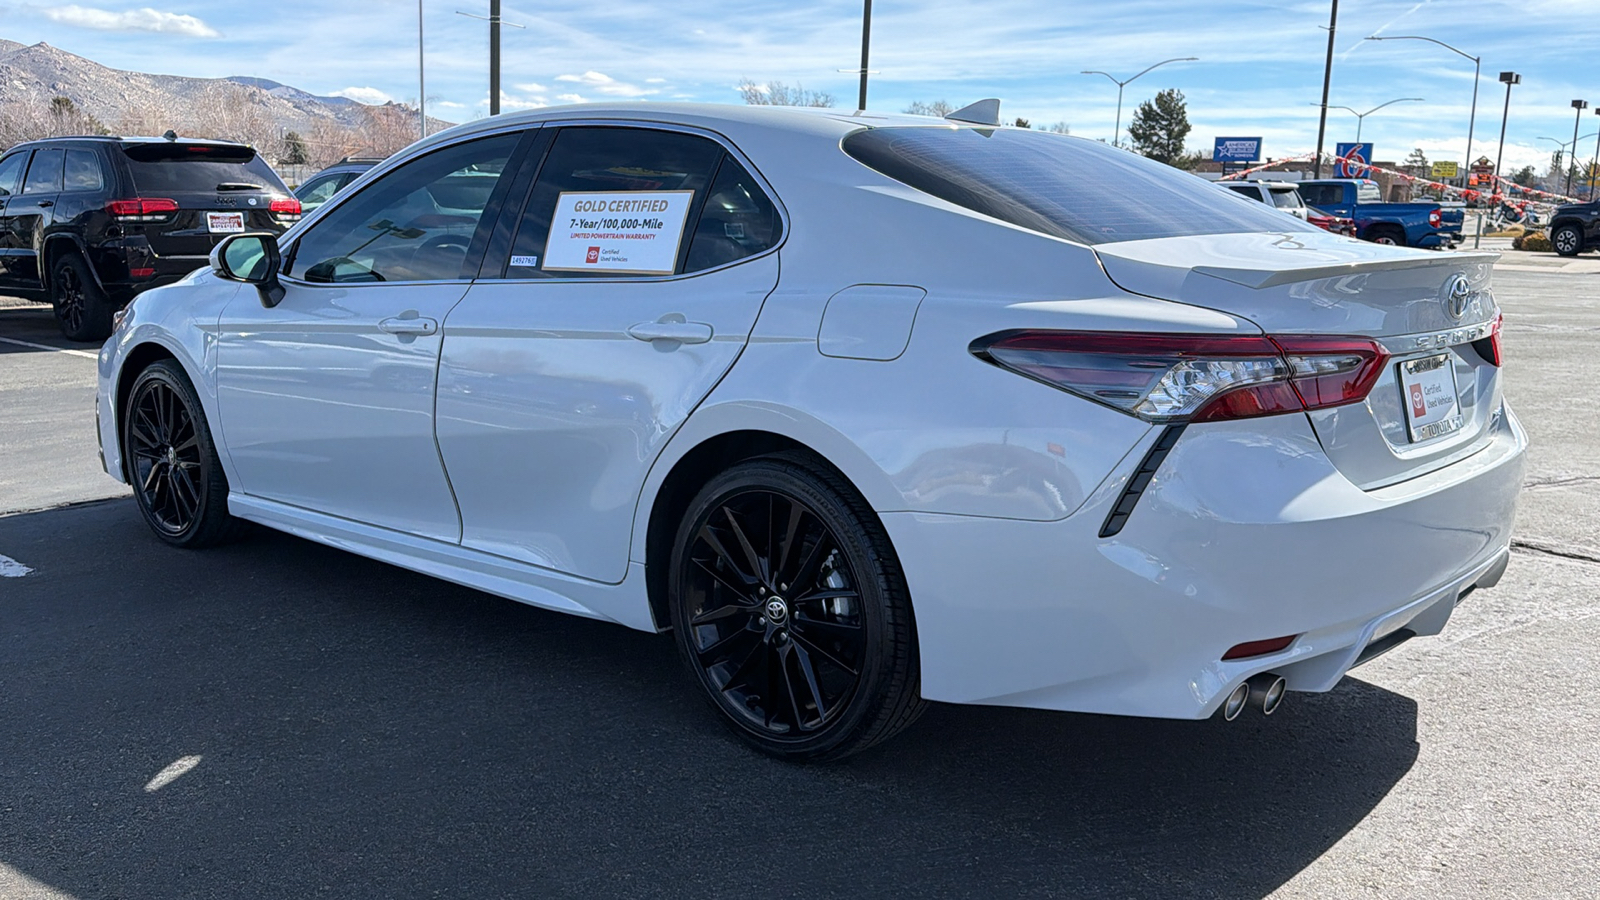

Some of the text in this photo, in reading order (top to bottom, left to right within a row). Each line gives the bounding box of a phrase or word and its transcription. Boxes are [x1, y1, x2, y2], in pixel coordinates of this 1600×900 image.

[1340, 143, 1366, 178] 6
[573, 199, 669, 213] GOLD CERTIFIED
[569, 218, 664, 231] 7-Year/100,000-Mile
[570, 232, 591, 240] LIMITED
[590, 232, 625, 240] POWERTRAIN
[1423, 383, 1442, 396] Certified
[1426, 394, 1453, 409] Used Vehicles
[1427, 419, 1453, 437] TOYOTA
